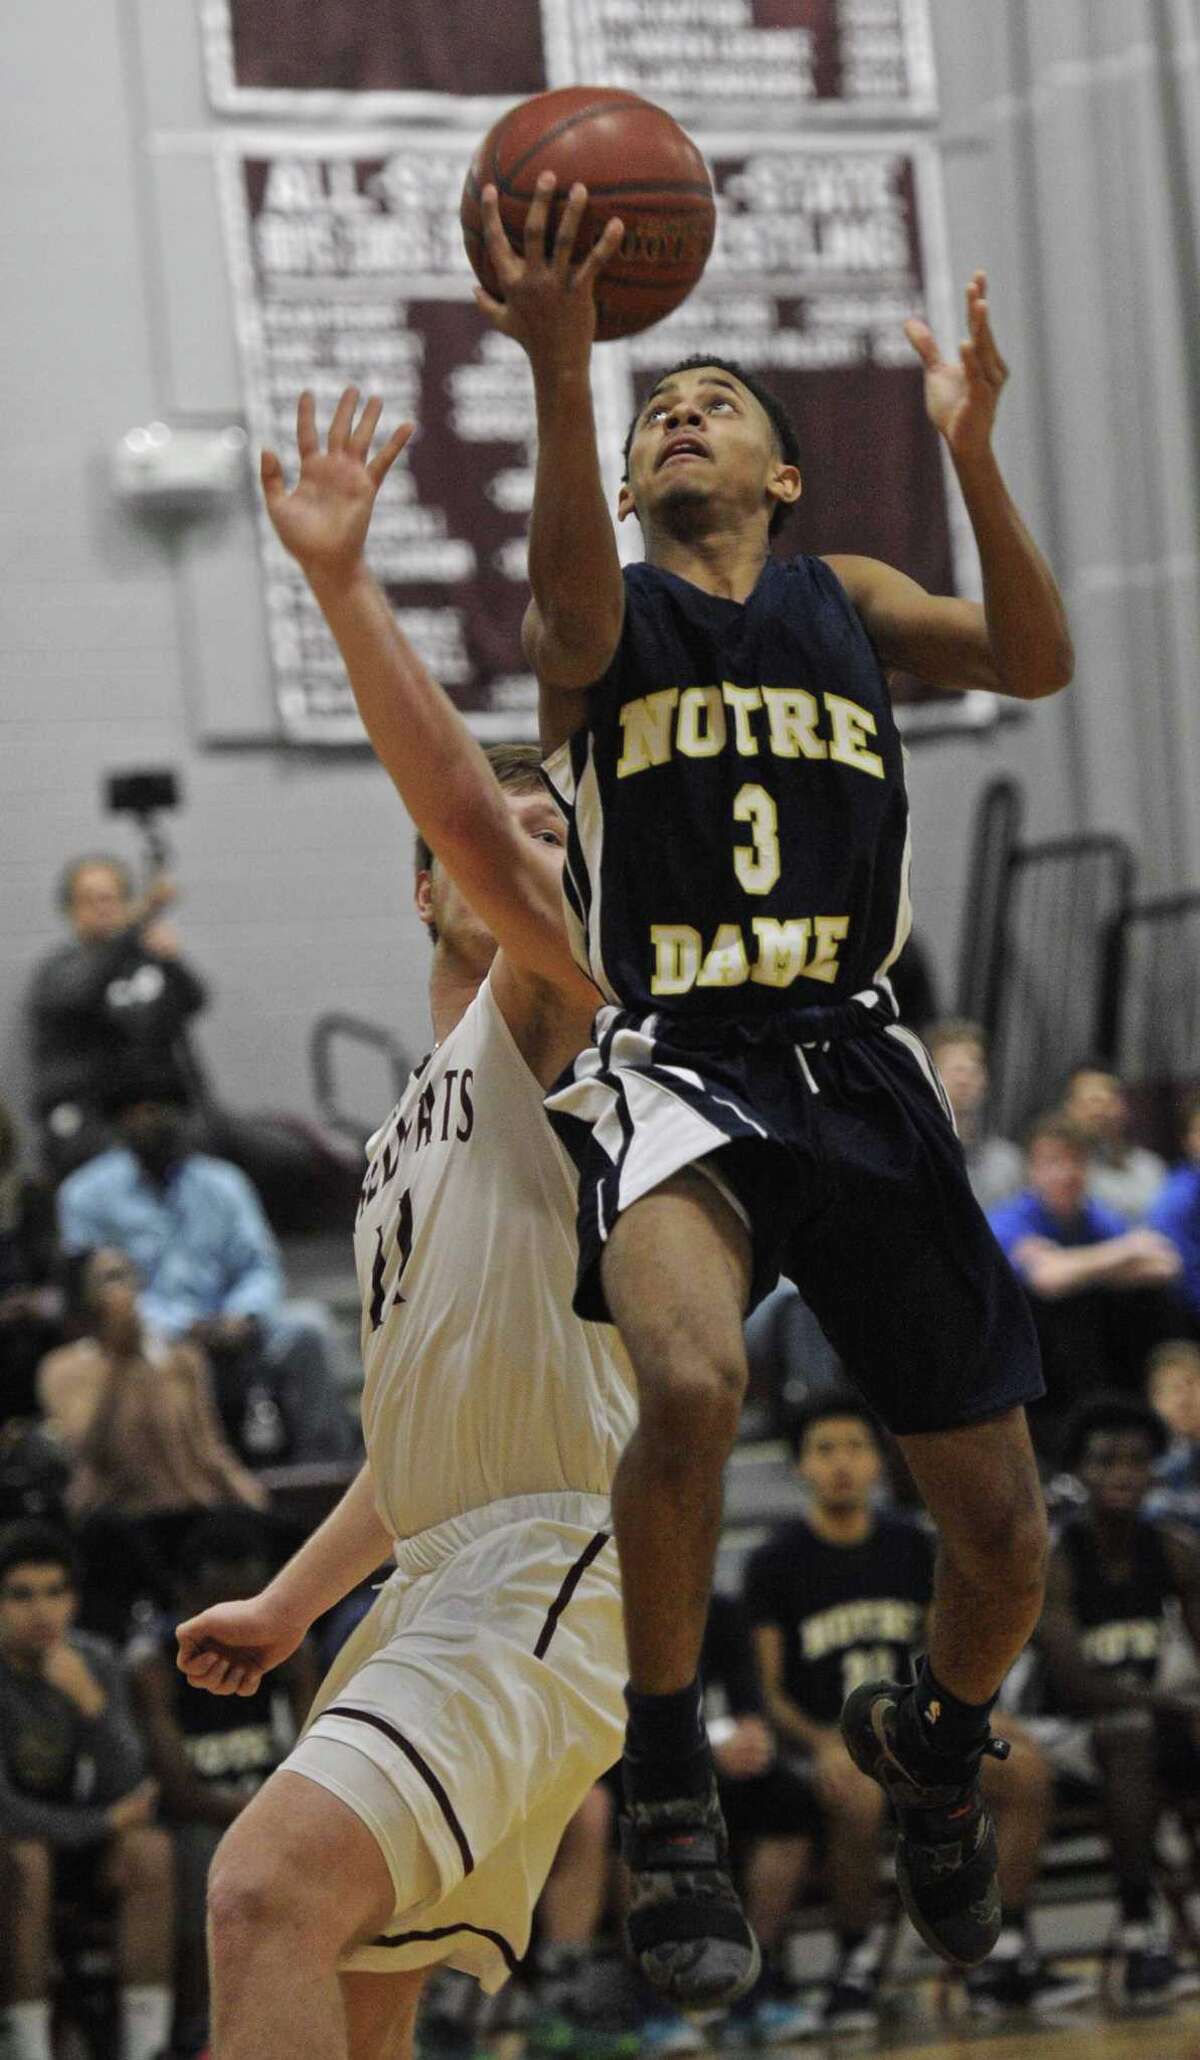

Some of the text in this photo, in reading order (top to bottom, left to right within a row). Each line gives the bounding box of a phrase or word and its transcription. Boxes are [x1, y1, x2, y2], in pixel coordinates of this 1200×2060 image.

[617, 680, 885, 779] NOTRE
[733, 783, 781, 895] 3
[650, 916, 850, 996] DAME
